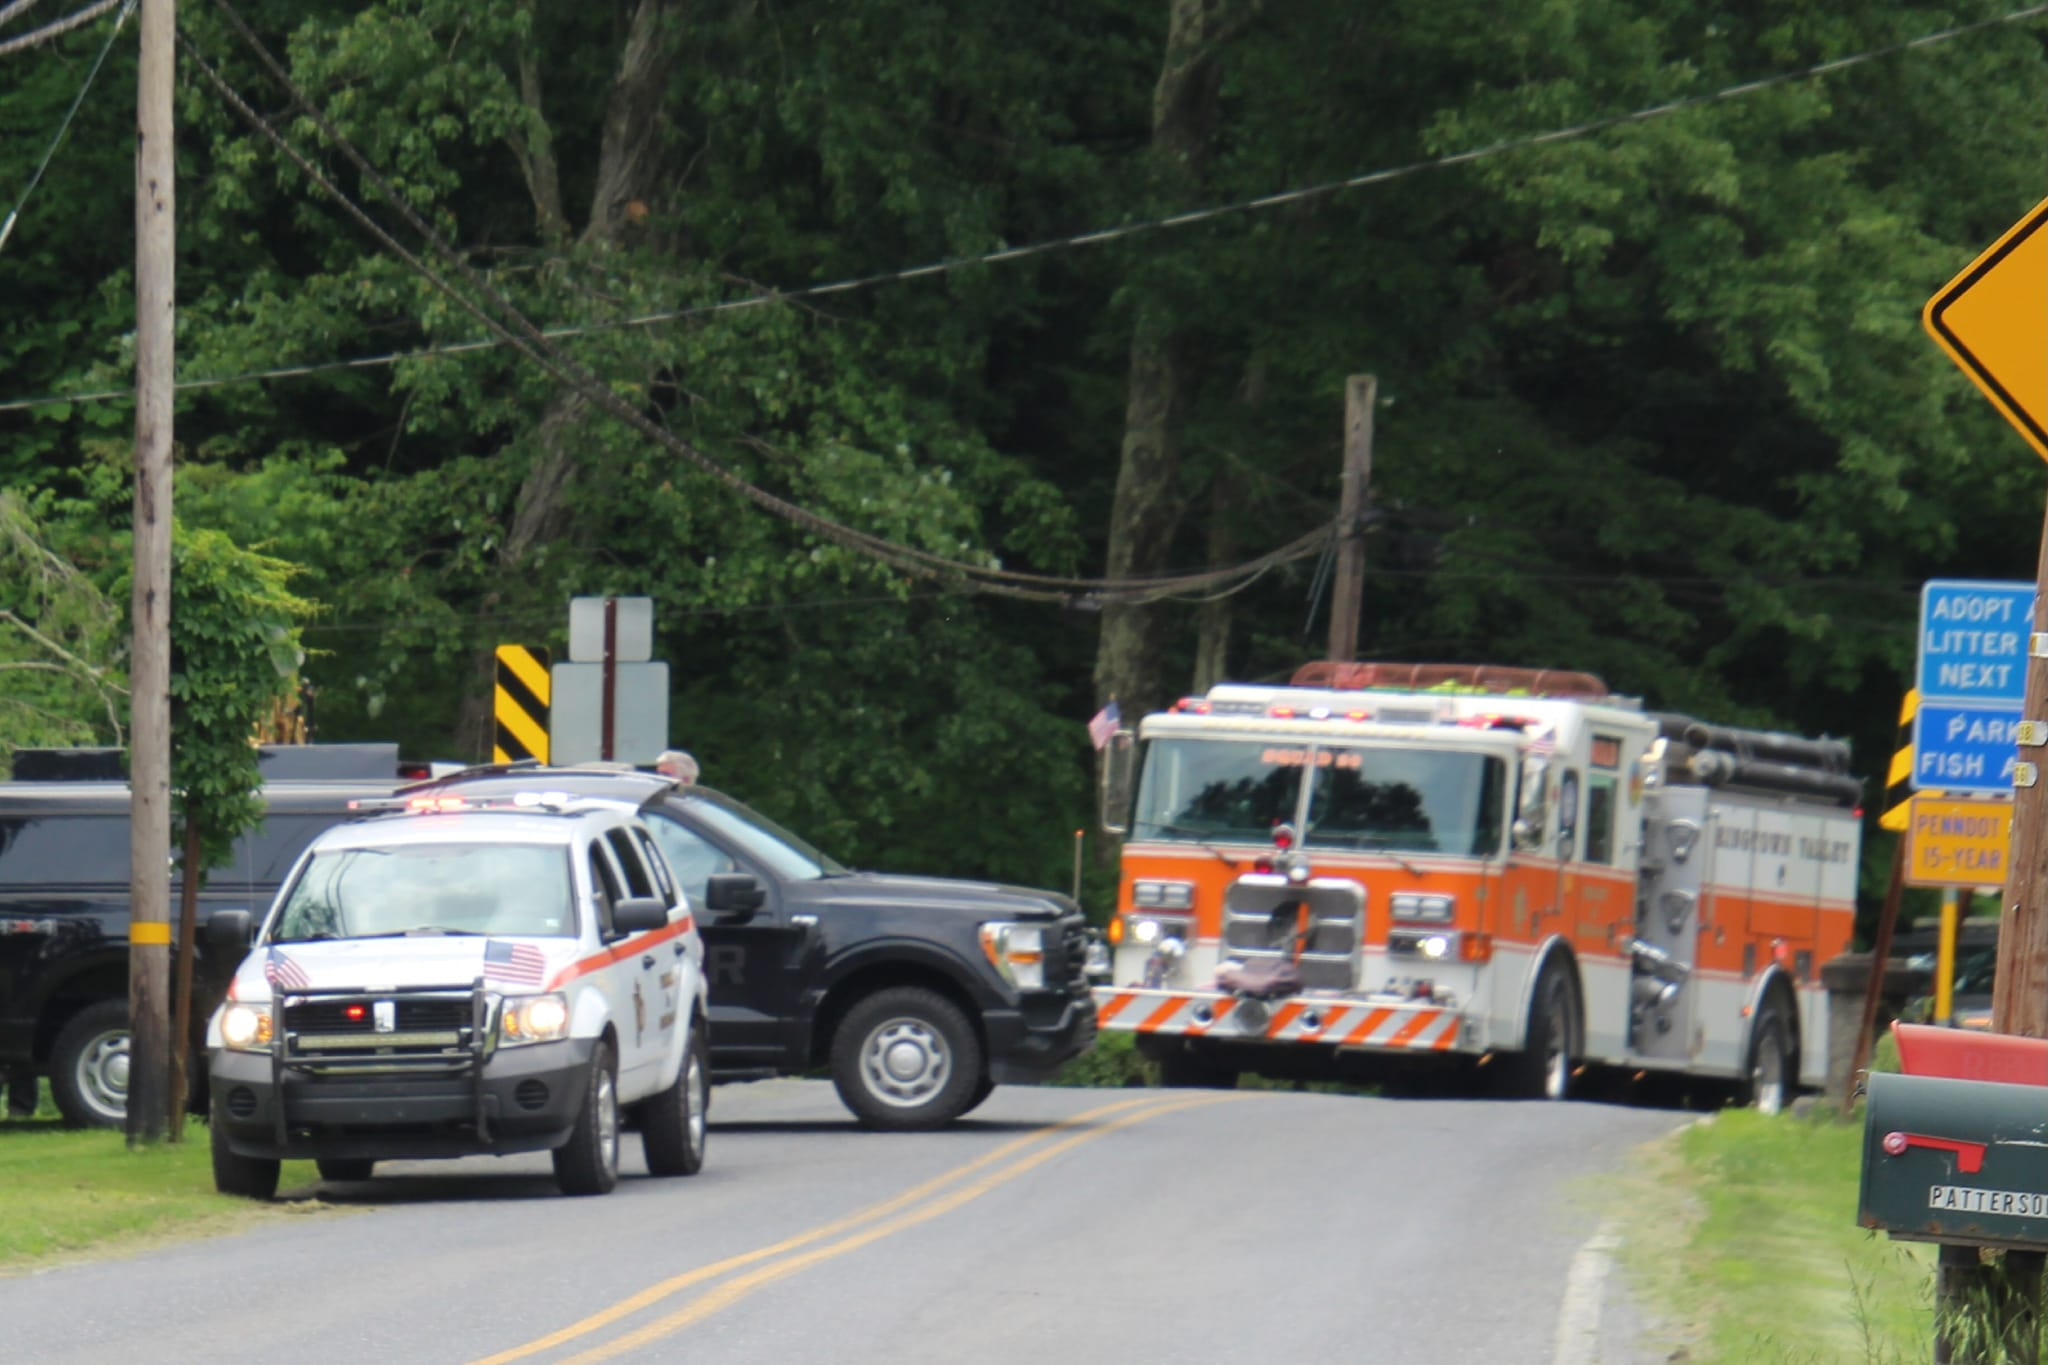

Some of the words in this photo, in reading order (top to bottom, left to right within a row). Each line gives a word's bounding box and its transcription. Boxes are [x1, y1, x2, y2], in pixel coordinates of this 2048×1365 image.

[1933, 596, 2014, 622] ADOPT
[1926, 629, 2019, 655] LITTER
[1939, 662, 2012, 689] NEXT
[1921, 752, 1985, 778] FISH
[1919, 814, 2000, 838] PENNDOT
[1924, 845, 2000, 871] 15-YEAR
[1931, 1186, 2048, 1216] PATTERSO
